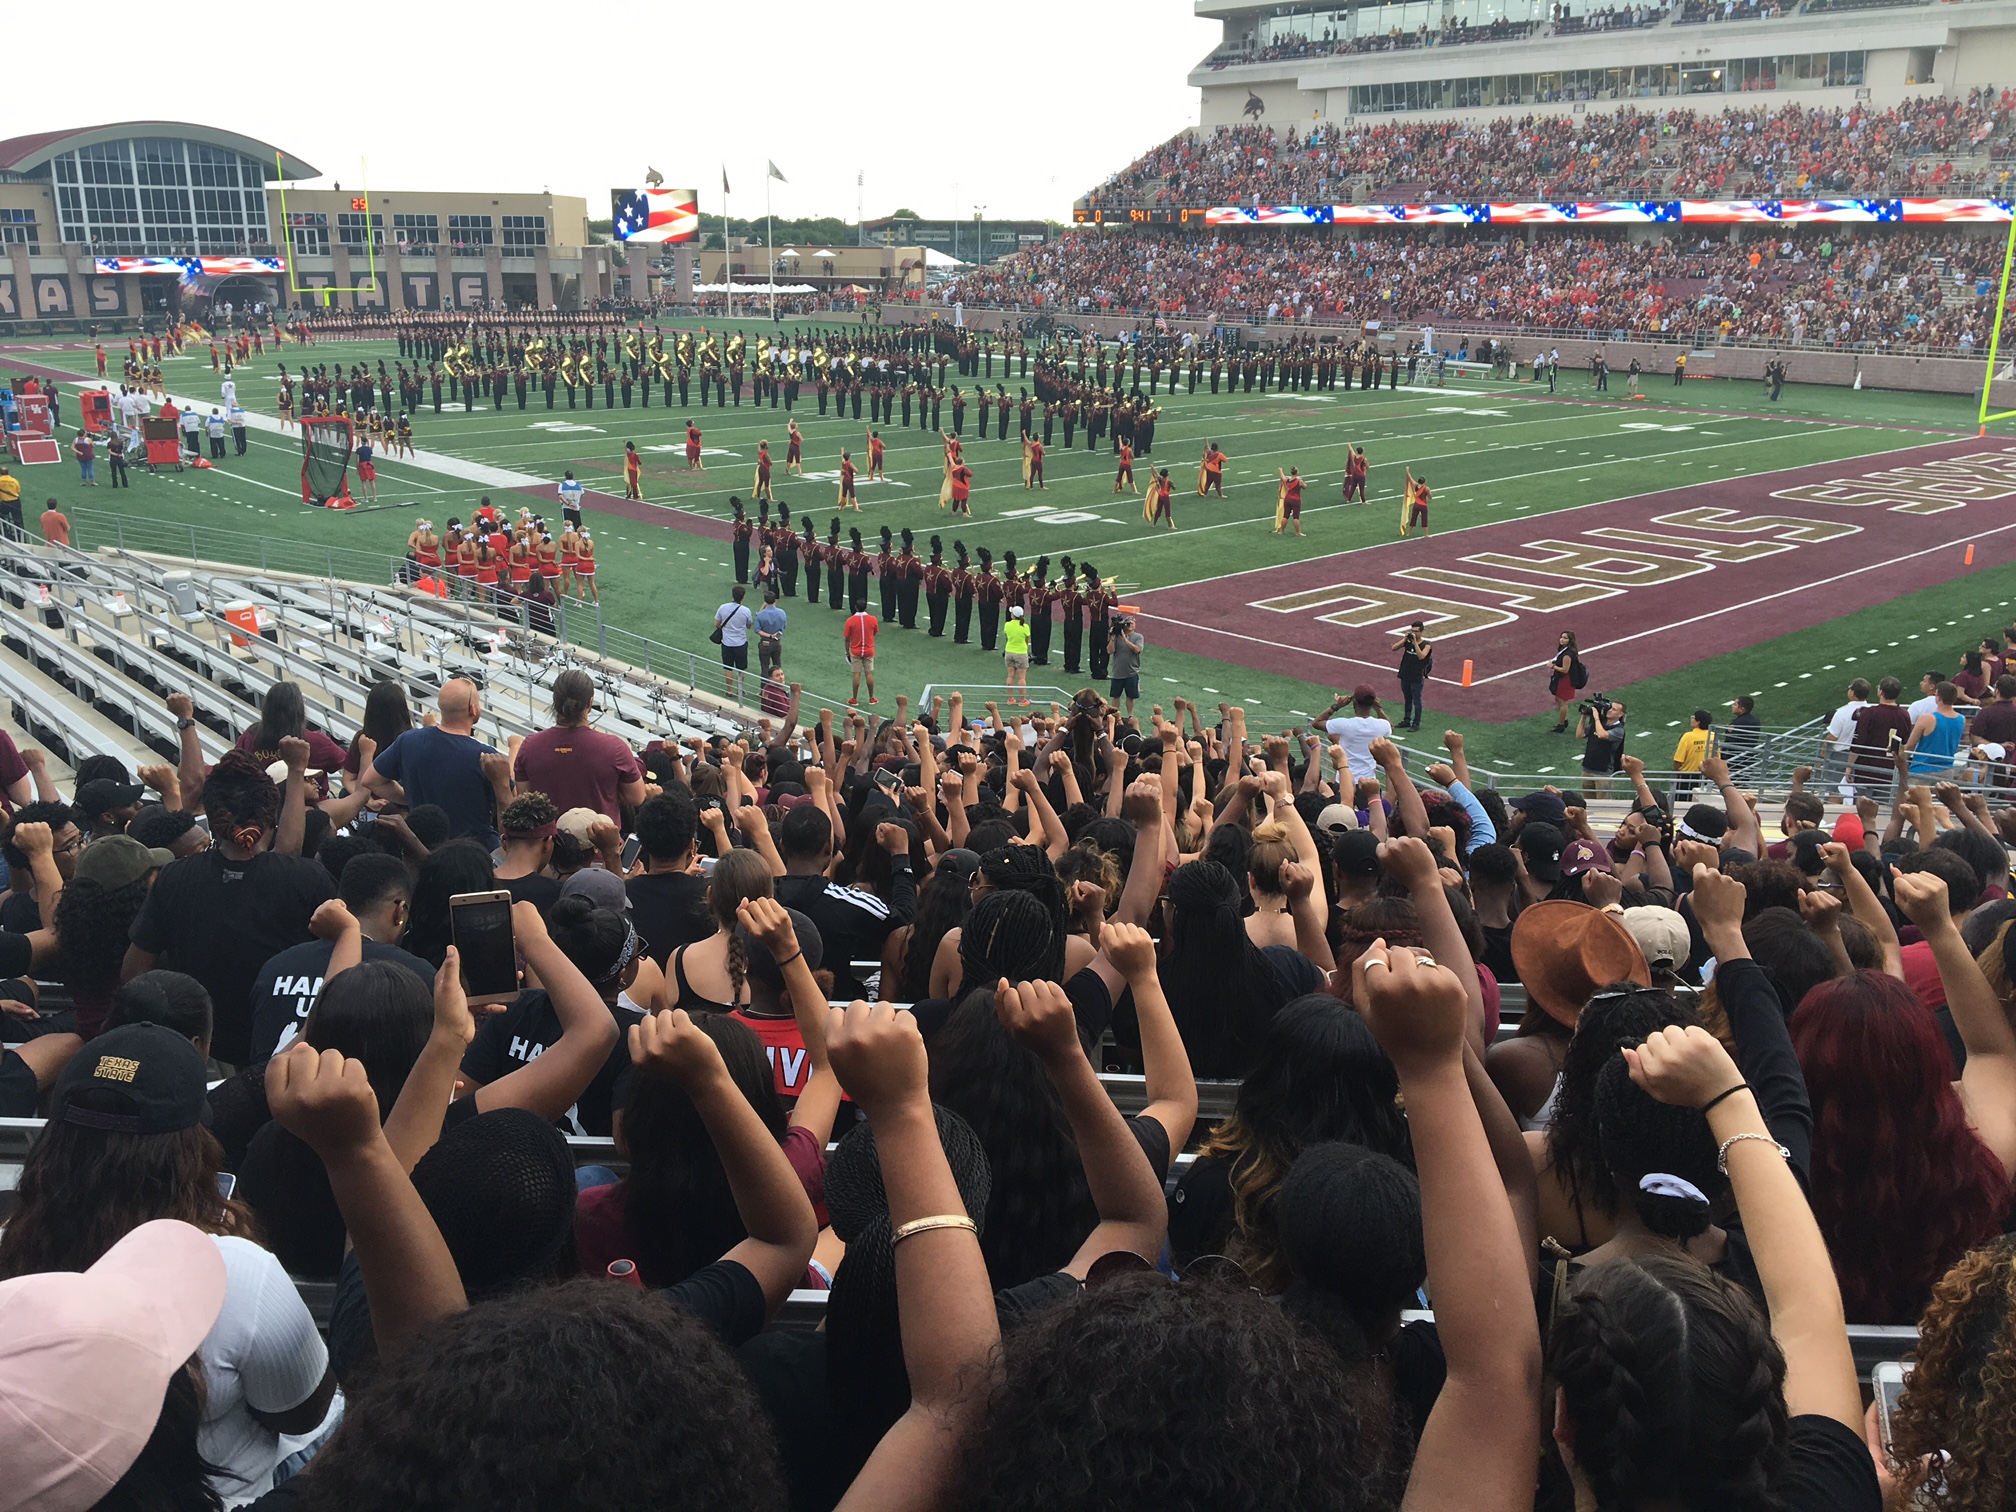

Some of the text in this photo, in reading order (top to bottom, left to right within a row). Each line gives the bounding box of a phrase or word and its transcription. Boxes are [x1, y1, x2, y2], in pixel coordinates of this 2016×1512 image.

[352, 199, 367, 209] 25
[1130, 209, 1151, 221] 9:41
[99, 1055, 141, 1072] TEXAS
[93, 1065, 136, 1083] STATE
